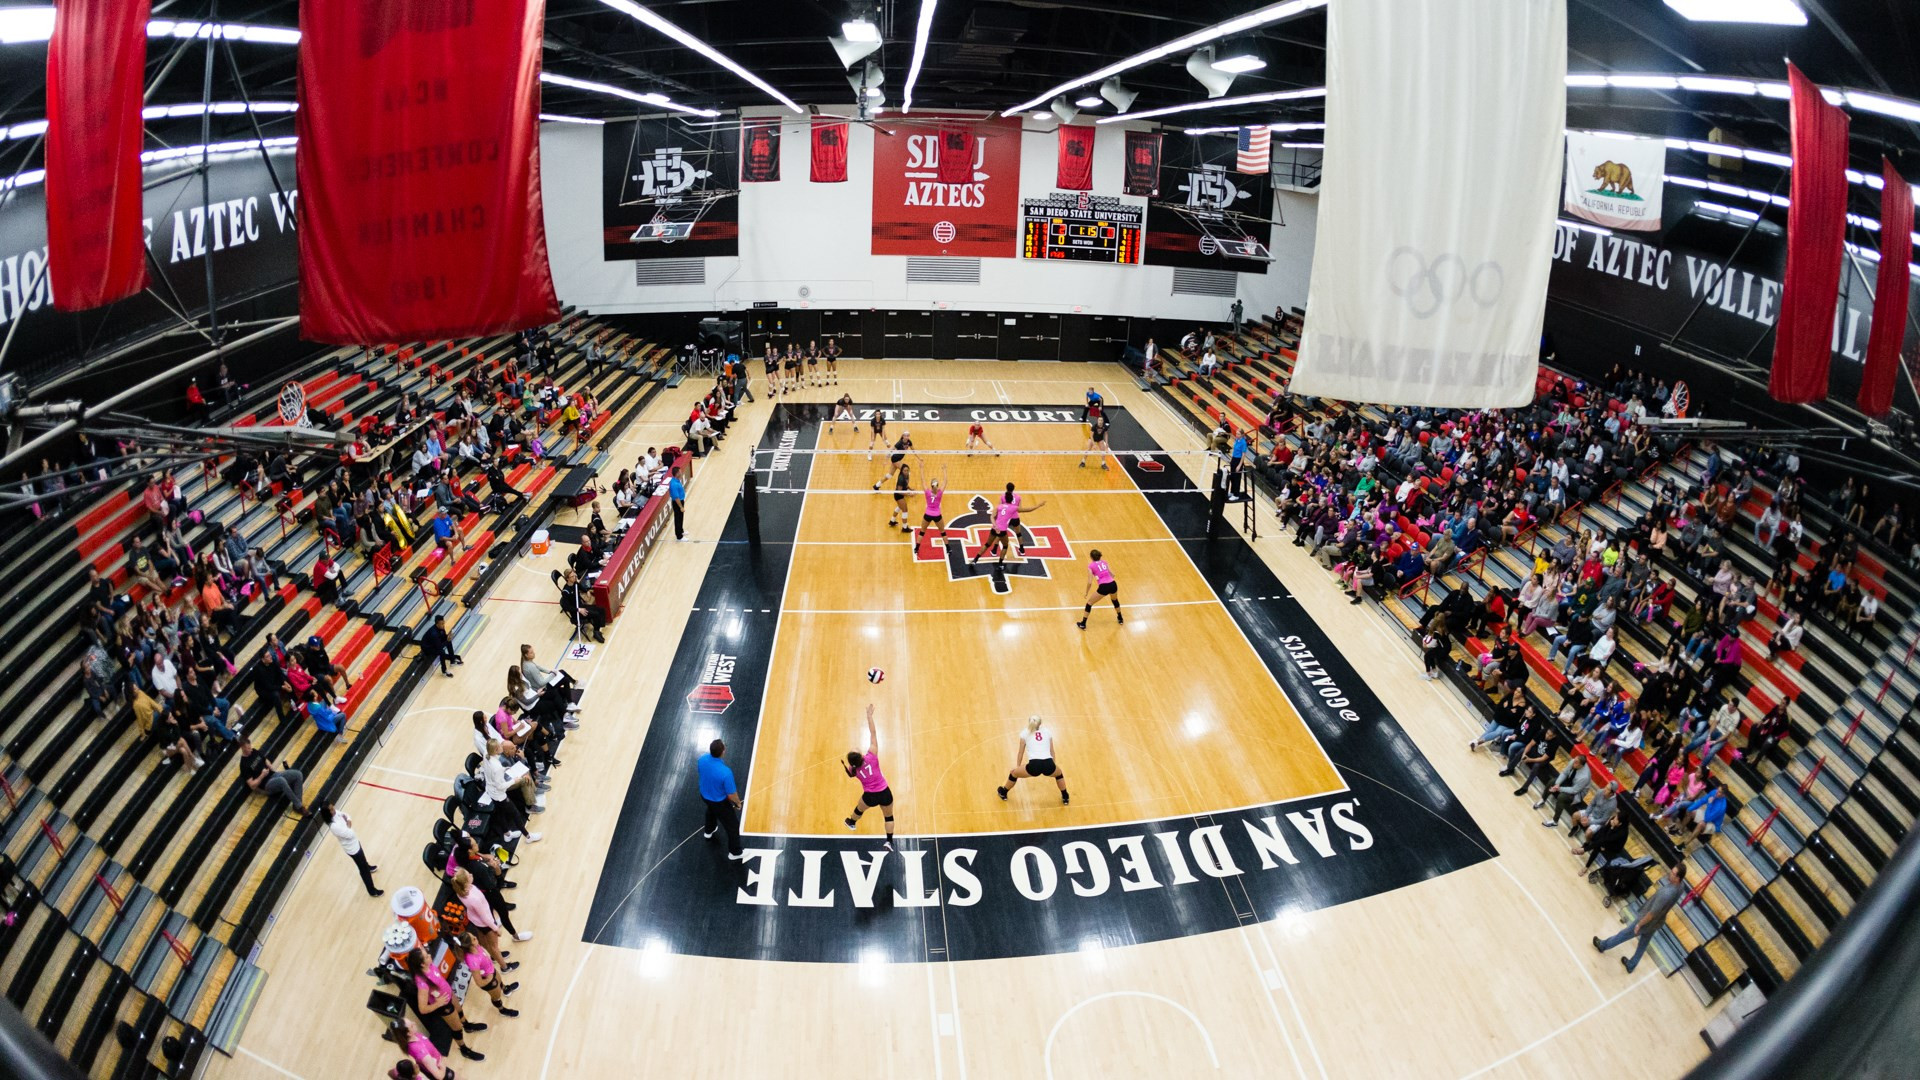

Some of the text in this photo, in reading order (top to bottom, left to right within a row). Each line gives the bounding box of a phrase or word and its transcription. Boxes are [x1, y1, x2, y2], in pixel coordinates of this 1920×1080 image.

[904, 182, 985, 208] AZTECS
[1030, 207, 1138, 222] SAN DIEGO STATE UNIVERSITY
[171, 196, 259, 263] AZTEC
[1552, 225, 1580, 263] OF
[1587, 232, 1672, 290] AZTEC
[837, 408, 1075, 422] AZTEC COURT
[1001, 508, 1006, 516] 6
[617, 543, 645, 599] AZTEC
[1097, 563, 1107, 572] 16
[712, 654, 737, 684] WEST
[1279, 635, 1361, 722] @GOAZTECS
[1035, 732, 1043, 741] 8
[859, 764, 873, 779] 17
[736, 798, 1374, 908] SAN DIEGO STATE
